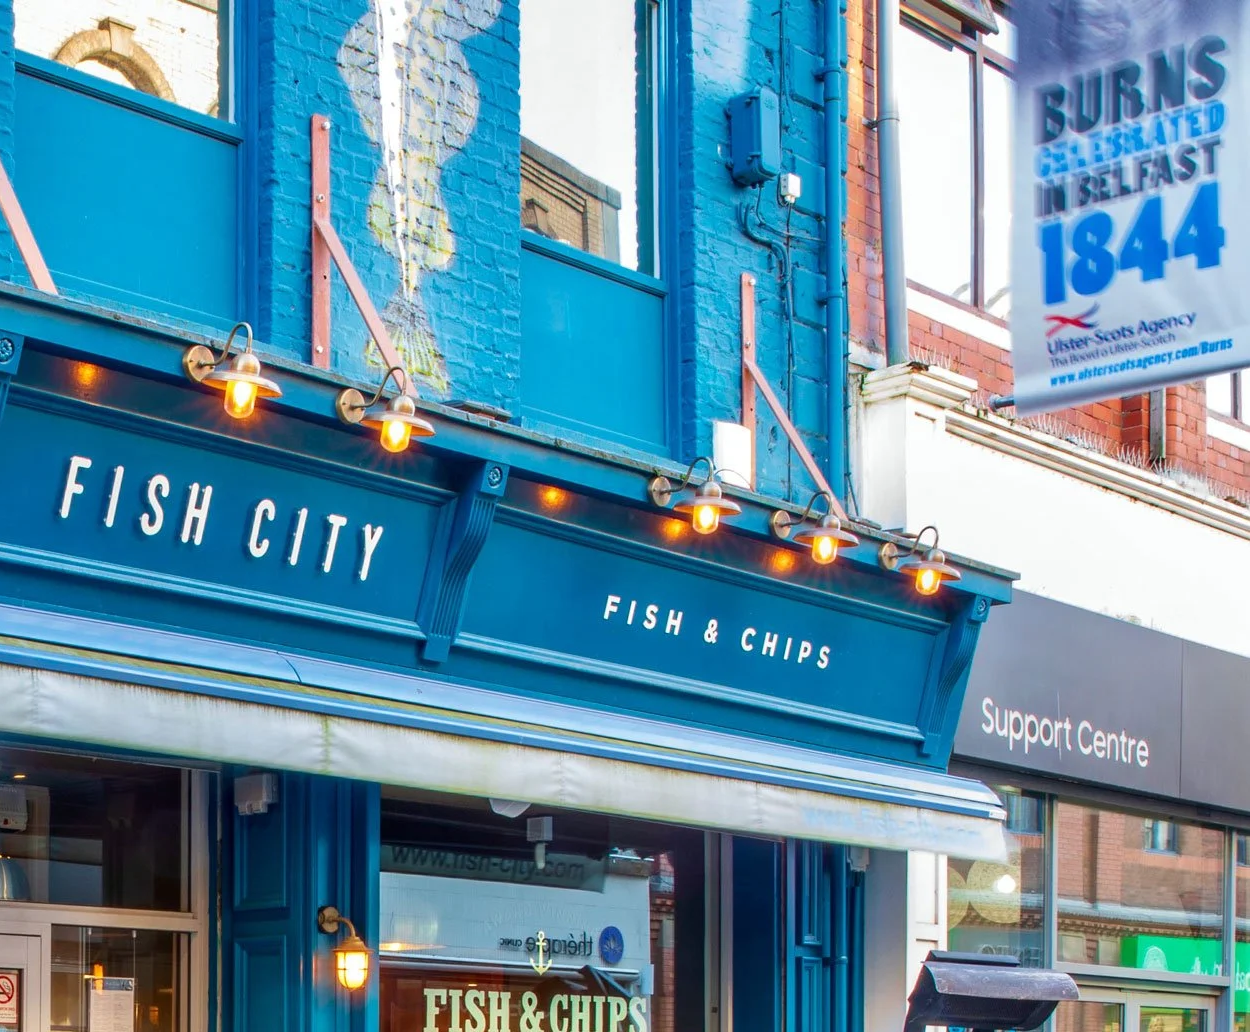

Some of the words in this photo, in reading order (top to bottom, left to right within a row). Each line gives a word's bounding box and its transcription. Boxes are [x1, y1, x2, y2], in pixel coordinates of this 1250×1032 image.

[1035, 33, 1227, 146] BURNS
[1035, 174, 1066, 218] IN
[1072, 134, 1223, 208] BELFAST
[1036, 98, 1225, 178] CELEBRATED
[1038, 179, 1225, 306] 1844
[1047, 323, 1135, 356] Ulster-Scots
[1137, 311, 1197, 337] Agency
[59, 456, 213, 546] FISH
[248, 499, 384, 581] CITY
[603, 594, 683, 636] FISH
[704, 619, 719, 644] &
[741, 627, 831, 669] CHIPS
[981, 697, 1072, 754] Support
[1077, 720, 1149, 768] Centre
